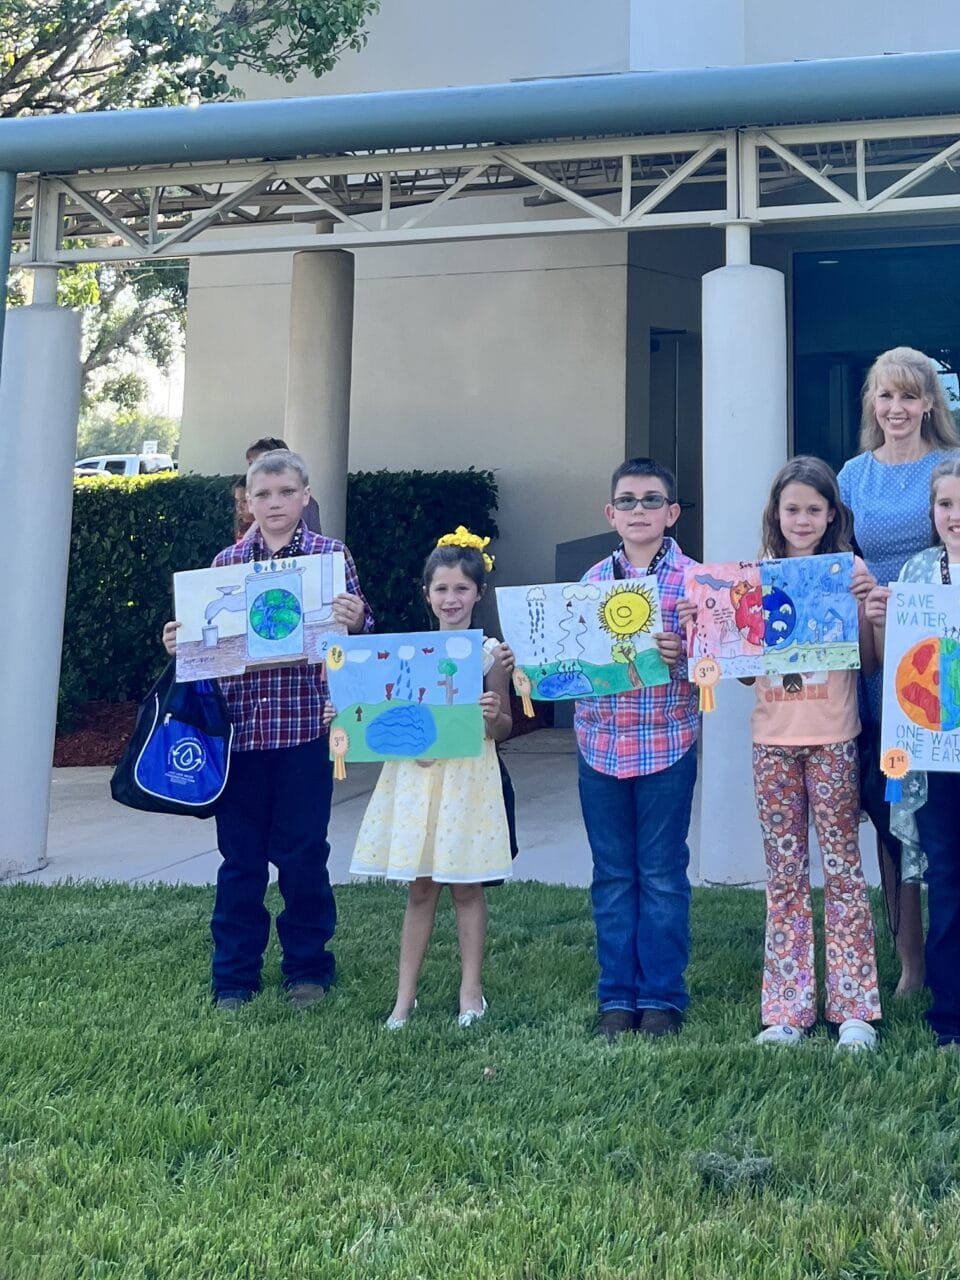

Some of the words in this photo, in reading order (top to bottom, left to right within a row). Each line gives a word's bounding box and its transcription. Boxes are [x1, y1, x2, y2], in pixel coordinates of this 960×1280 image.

[896, 592, 935, 609] SAVE
[896, 610, 947, 627] WATER
[896, 724, 924, 742] ONE
[889, 755, 904, 769] 1st
